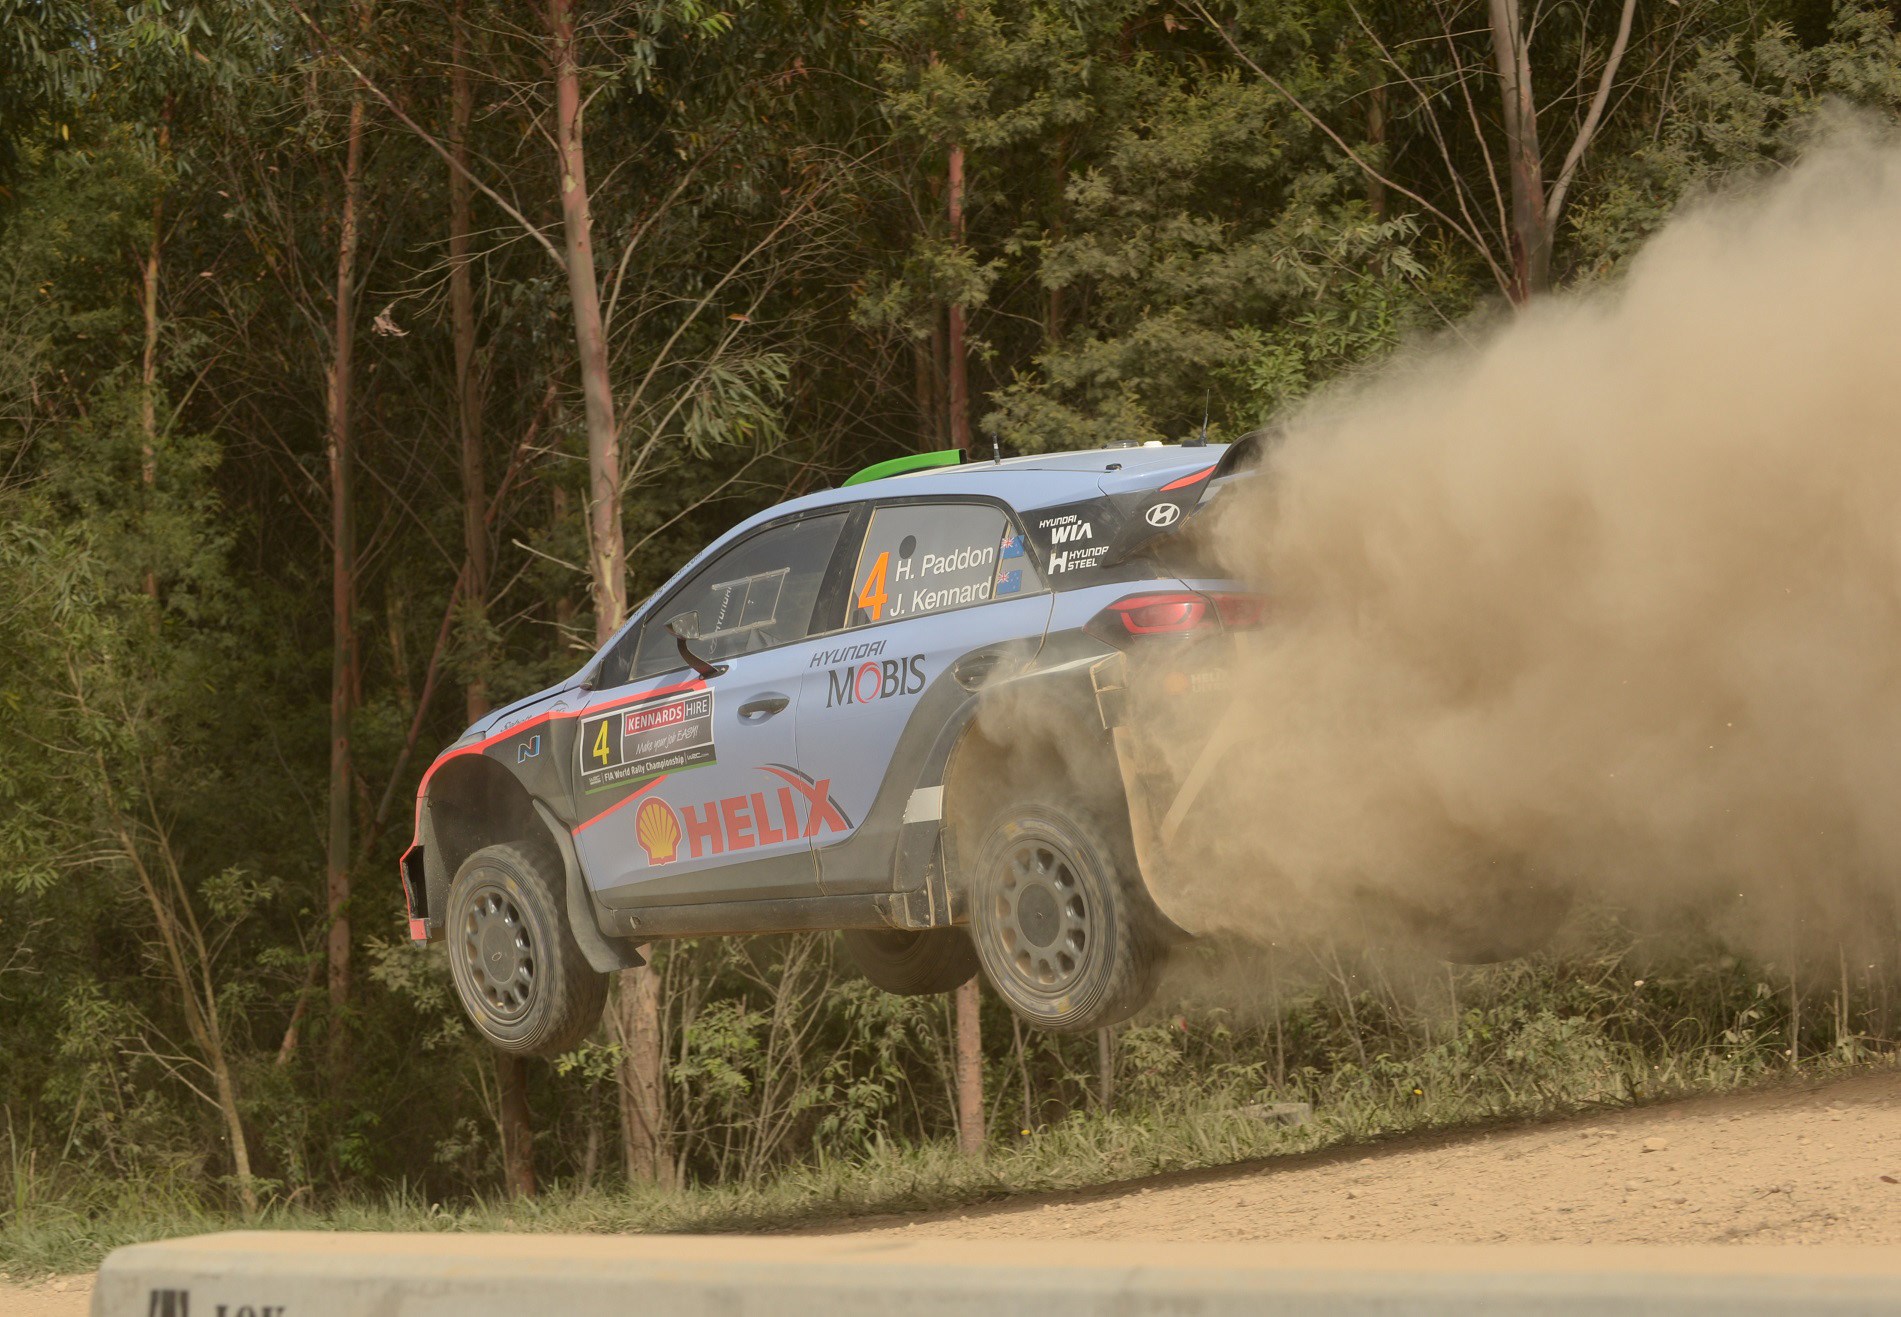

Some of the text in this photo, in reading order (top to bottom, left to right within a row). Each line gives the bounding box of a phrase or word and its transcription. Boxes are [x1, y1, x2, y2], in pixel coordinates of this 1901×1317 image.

[1039, 514, 1077, 529] HYUNDAI
[895, 546, 994, 582] H. Paddon
[1068, 558, 1097, 571] STEEL
[858, 552, 890, 621] 4
[890, 576, 992, 617] J. Kennard
[809, 640, 887, 668] HYUNDAI
[826, 654, 926, 708] MOBIS
[628, 699, 709, 731] KENNARDS HIRE
[592, 719, 610, 765] 4
[635, 740, 653, 755] Make
[654, 737, 667, 752] your
[665, 732, 677, 749] job
[604, 755, 684, 782] FIA World Rally Championship
[678, 778, 849, 858] HELIX
